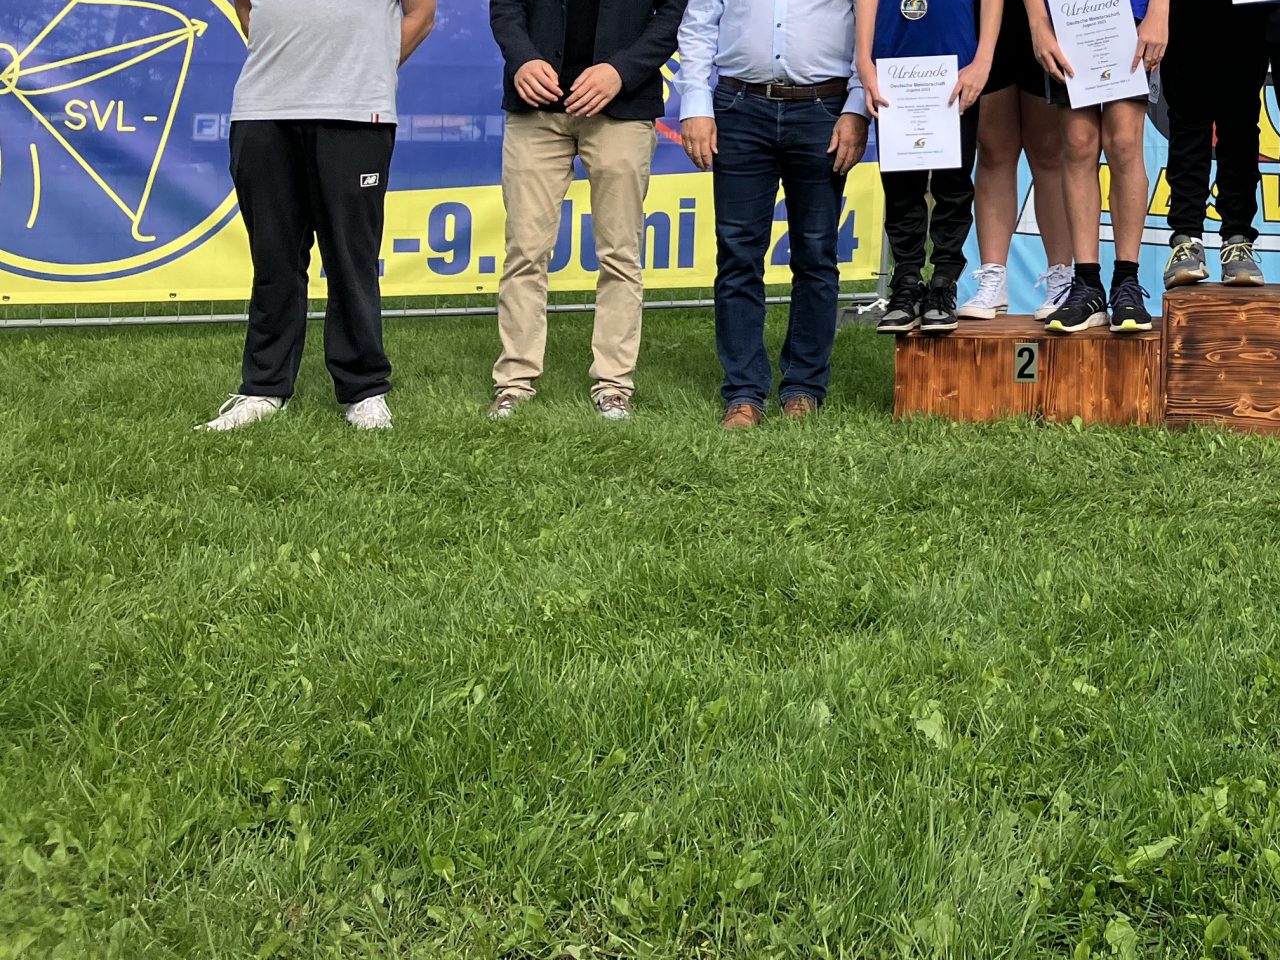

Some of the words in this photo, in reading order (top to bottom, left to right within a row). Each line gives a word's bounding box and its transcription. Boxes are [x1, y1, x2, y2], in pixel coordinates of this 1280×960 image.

[888, 62, 948, 79] Urkunde
[378, 200, 496, 276] -9.
[1017, 347, 1035, 379] 2
